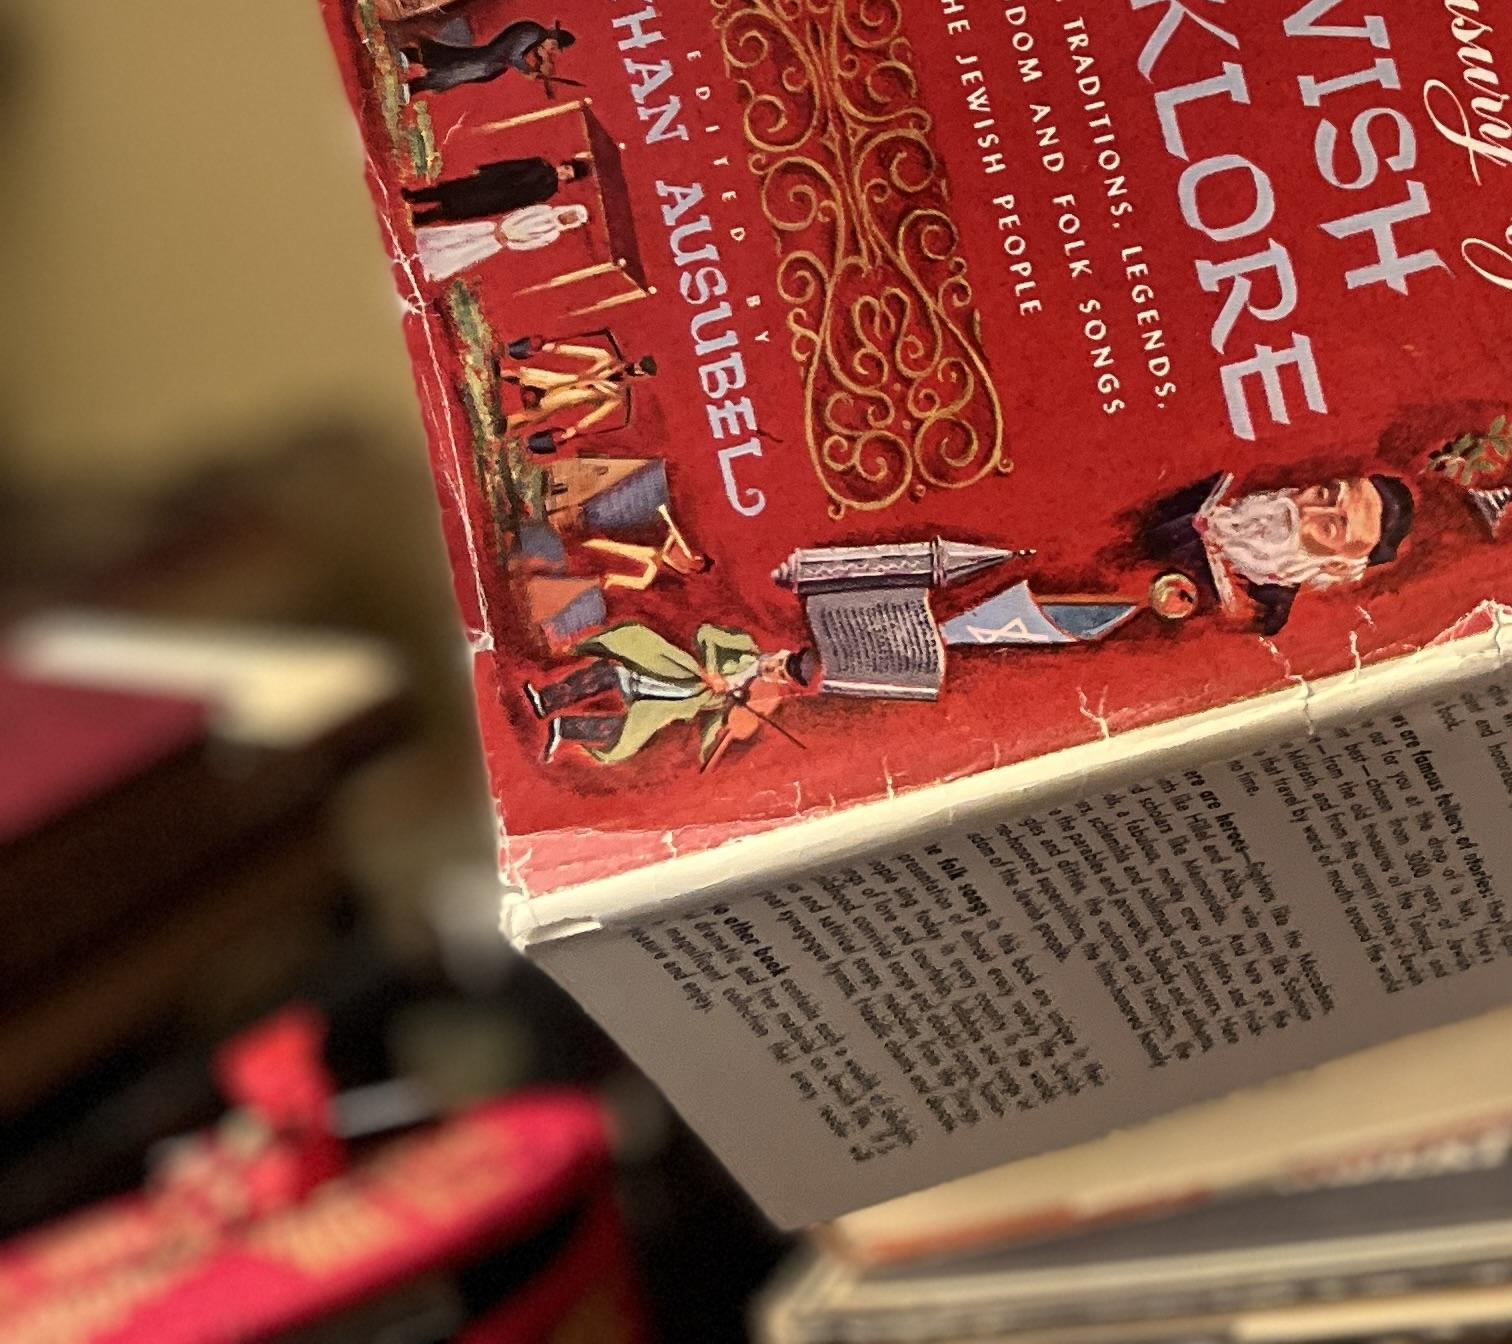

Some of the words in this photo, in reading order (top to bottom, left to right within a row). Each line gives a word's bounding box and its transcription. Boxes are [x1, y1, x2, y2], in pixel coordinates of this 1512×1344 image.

[686, 50, 745, 241] EDITED
[745, 294, 769, 341] BY
[955, 54, 1006, 173] JEWISH
[992, 193, 1042, 315] PEOPLE
[1028, 103, 1064, 172] AND
[1052, 193, 1092, 278] FOLK
[1078, 298, 1125, 414] SONGS
[1063, 16, 1132, 228] TRADITIONS,
[1120, 245, 1176, 408] LEGENDS,
[655, 180, 765, 516] AUSUBEL
